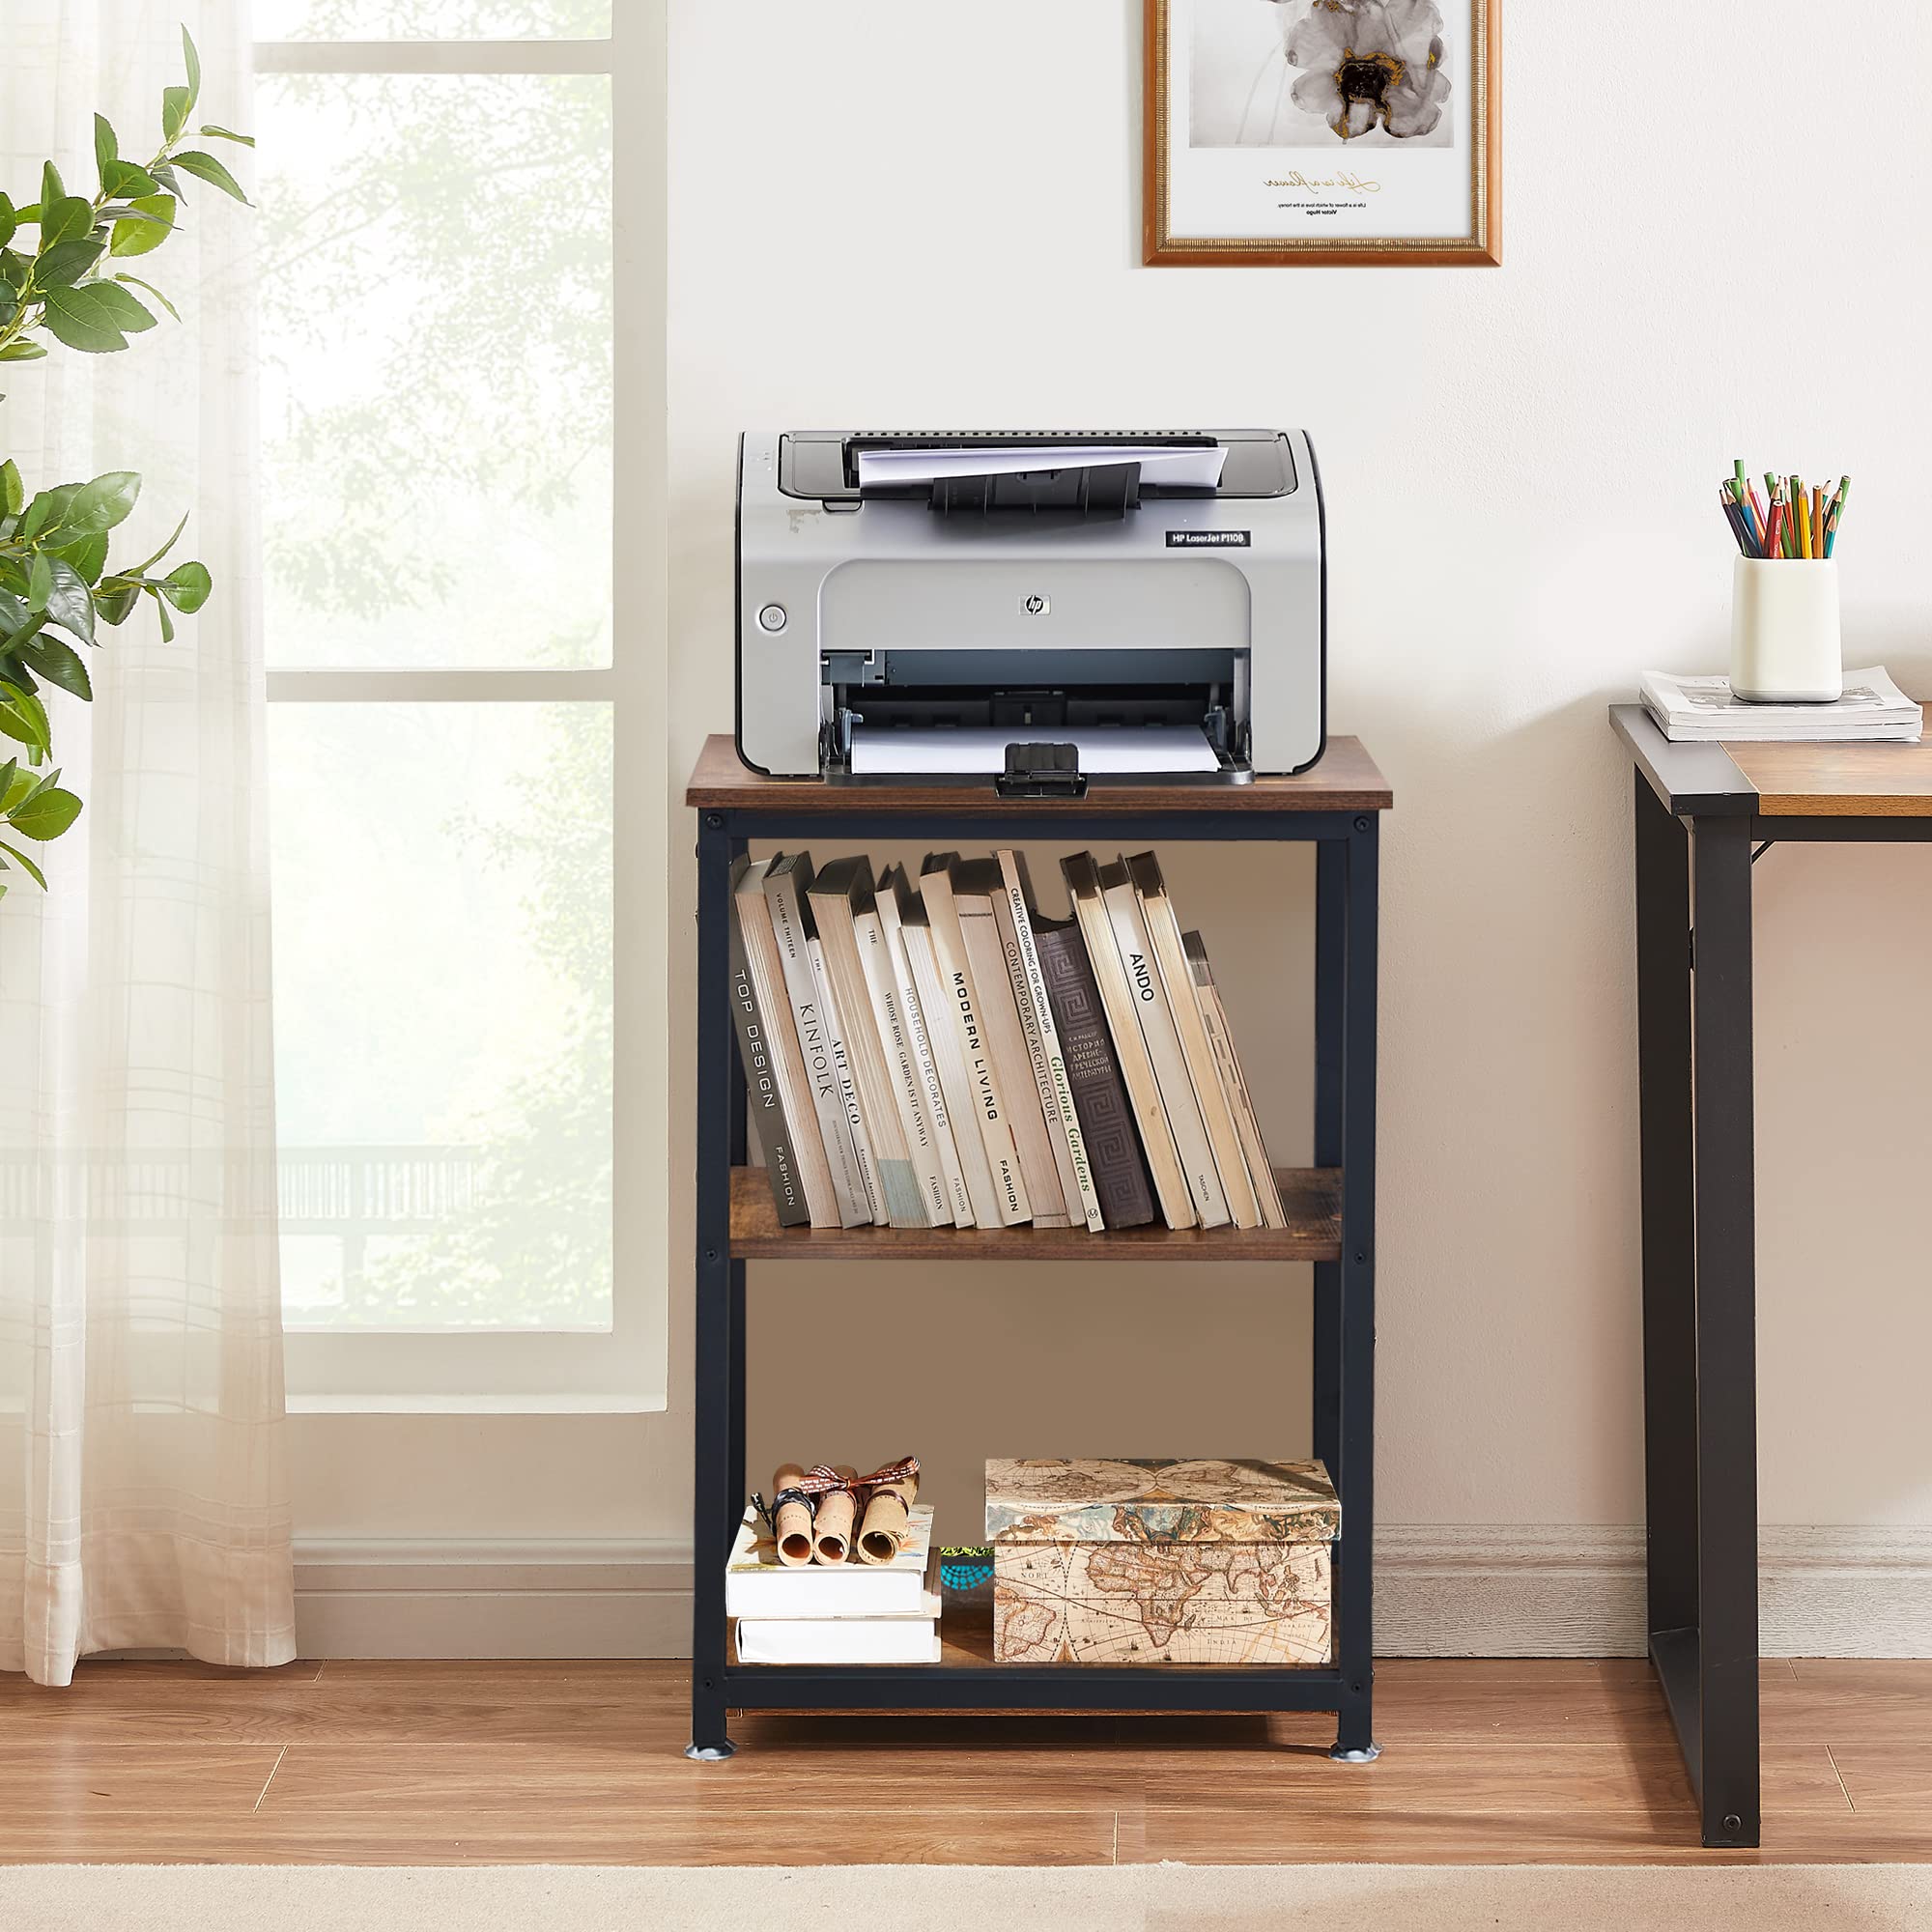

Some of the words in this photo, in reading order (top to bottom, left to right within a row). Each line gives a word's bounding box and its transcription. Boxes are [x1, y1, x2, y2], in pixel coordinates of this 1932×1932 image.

[1026, 595, 1043, 615] hp
[776, 893, 788, 924] VOLUME
[784, 926, 797, 958] THITEEN
[1010, 888, 1026, 923] CREATIVE
[868, 929, 878, 945] THE
[1019, 924, 1037, 967] COLORING
[1030, 968, 1040, 984] FOR
[1129, 952, 1154, 1002] ANDO
[885, 992, 898, 1024] WHOSE
[1034, 985, 1052, 1035] GROWN-UPS
[735, 969, 753, 1012] TOP
[747, 1025, 776, 1108] DESIGN
[800, 1004, 834, 1098] KINFOLK
[893, 1025, 904, 1048] ROSE
[952, 972, 980, 1050] MODERN
[974, 1059, 998, 1121] LIVING
[1006, 941, 1037, 1036] CONTEMPORARY
[1029, 1038, 1058, 1123] ARCHITECTURE
[898, 1051, 914, 1089] GARDEN
[904, 987, 928, 1058] HOUSEHOLD
[923, 1062, 947, 1128] DECORATES
[832, 1038, 849, 1070] ART
[841, 1079, 861, 1124] DECO
[913, 1109, 929, 1148] ANYWAY
[1050, 1056, 1073, 1122] Glorious
[1067, 1127, 1091, 1193] Gardens
[776, 1146, 795, 1207] FASHION
[929, 1176, 944, 1210] FASHION
[952, 1178, 966, 1212] FASHION
[1000, 1159, 1019, 1212] FASHION
[1198, 1174, 1210, 1202] TASCHEN
